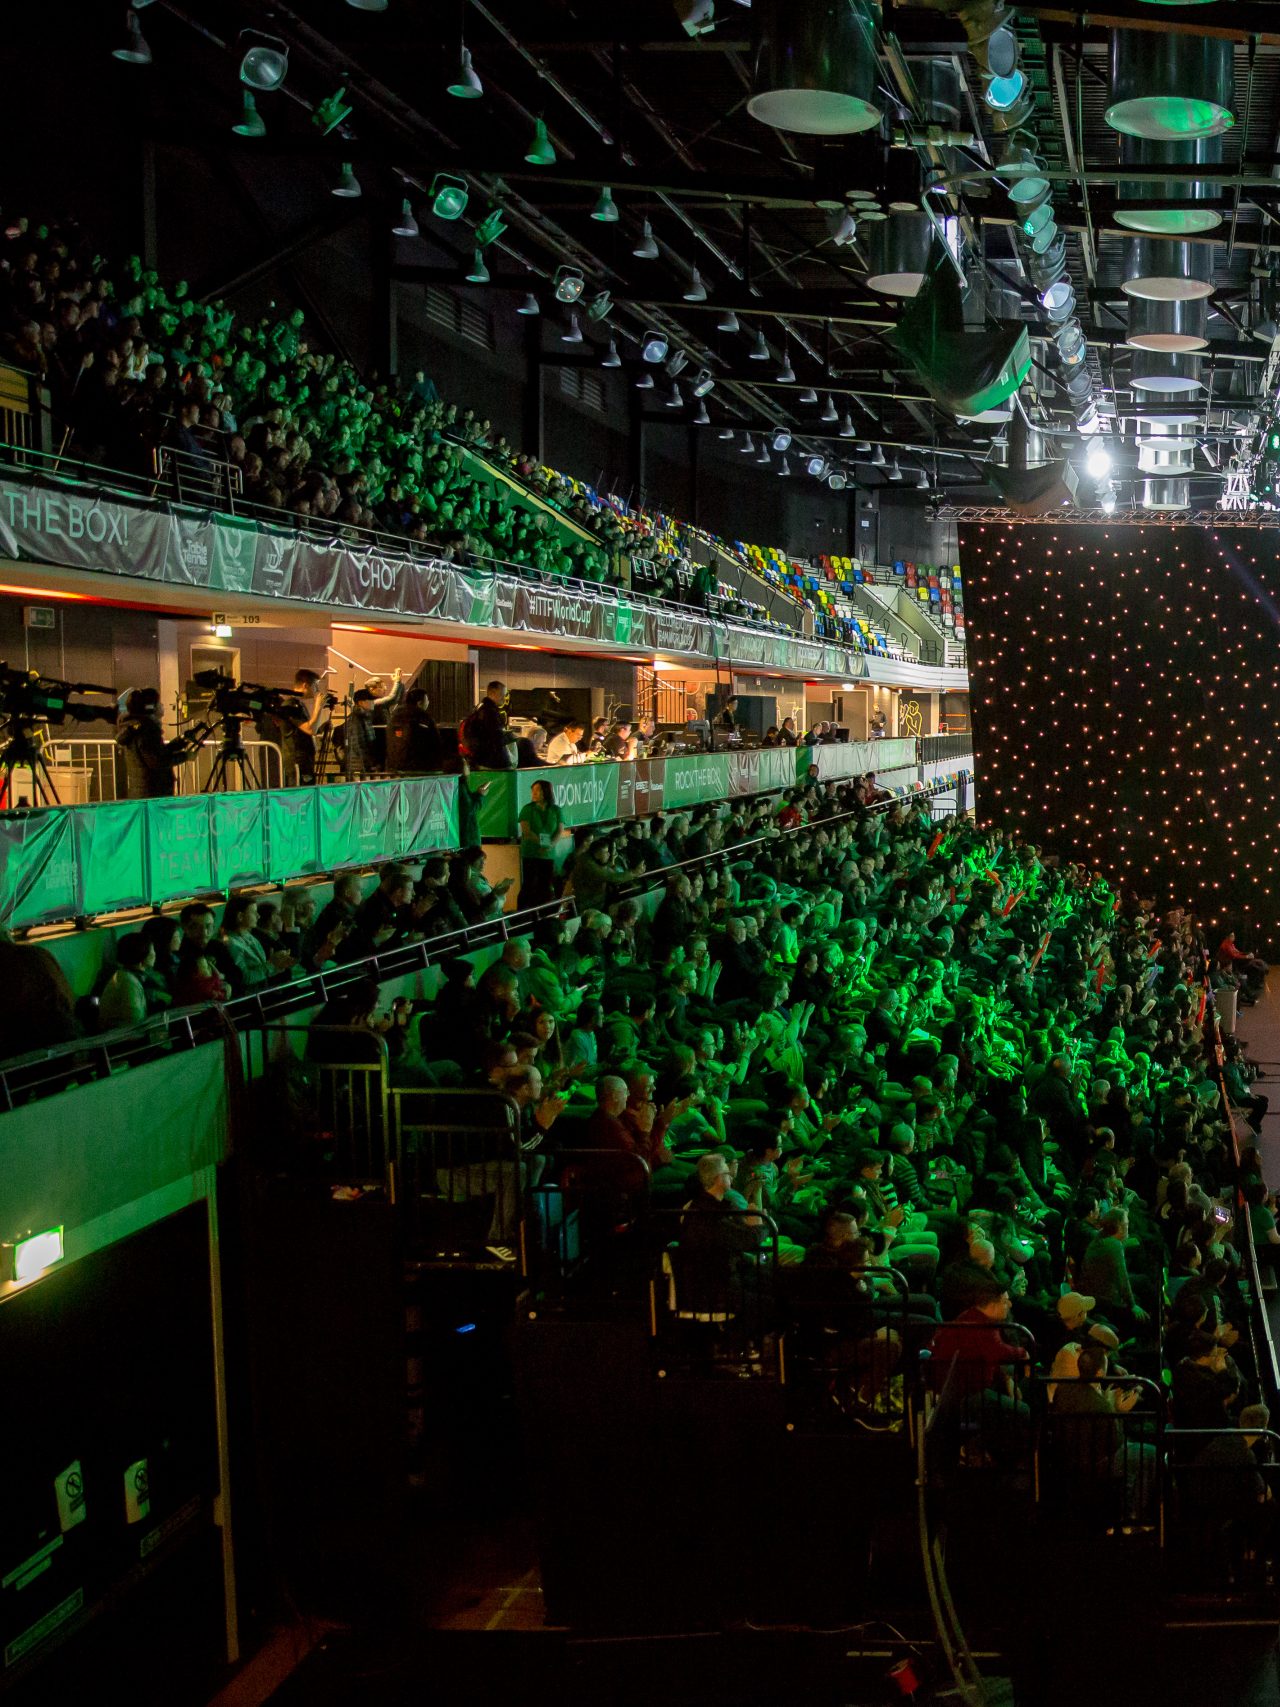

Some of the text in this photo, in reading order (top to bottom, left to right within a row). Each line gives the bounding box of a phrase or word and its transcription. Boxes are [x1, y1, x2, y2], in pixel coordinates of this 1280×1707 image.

[3, 491, 129, 547] THE BOX!
[359, 562, 397, 591] CHO!
[242, 615, 260, 624] 103
[529, 595, 592, 629] #ITTFWorldCup
[582, 779, 604, 804] 2018
